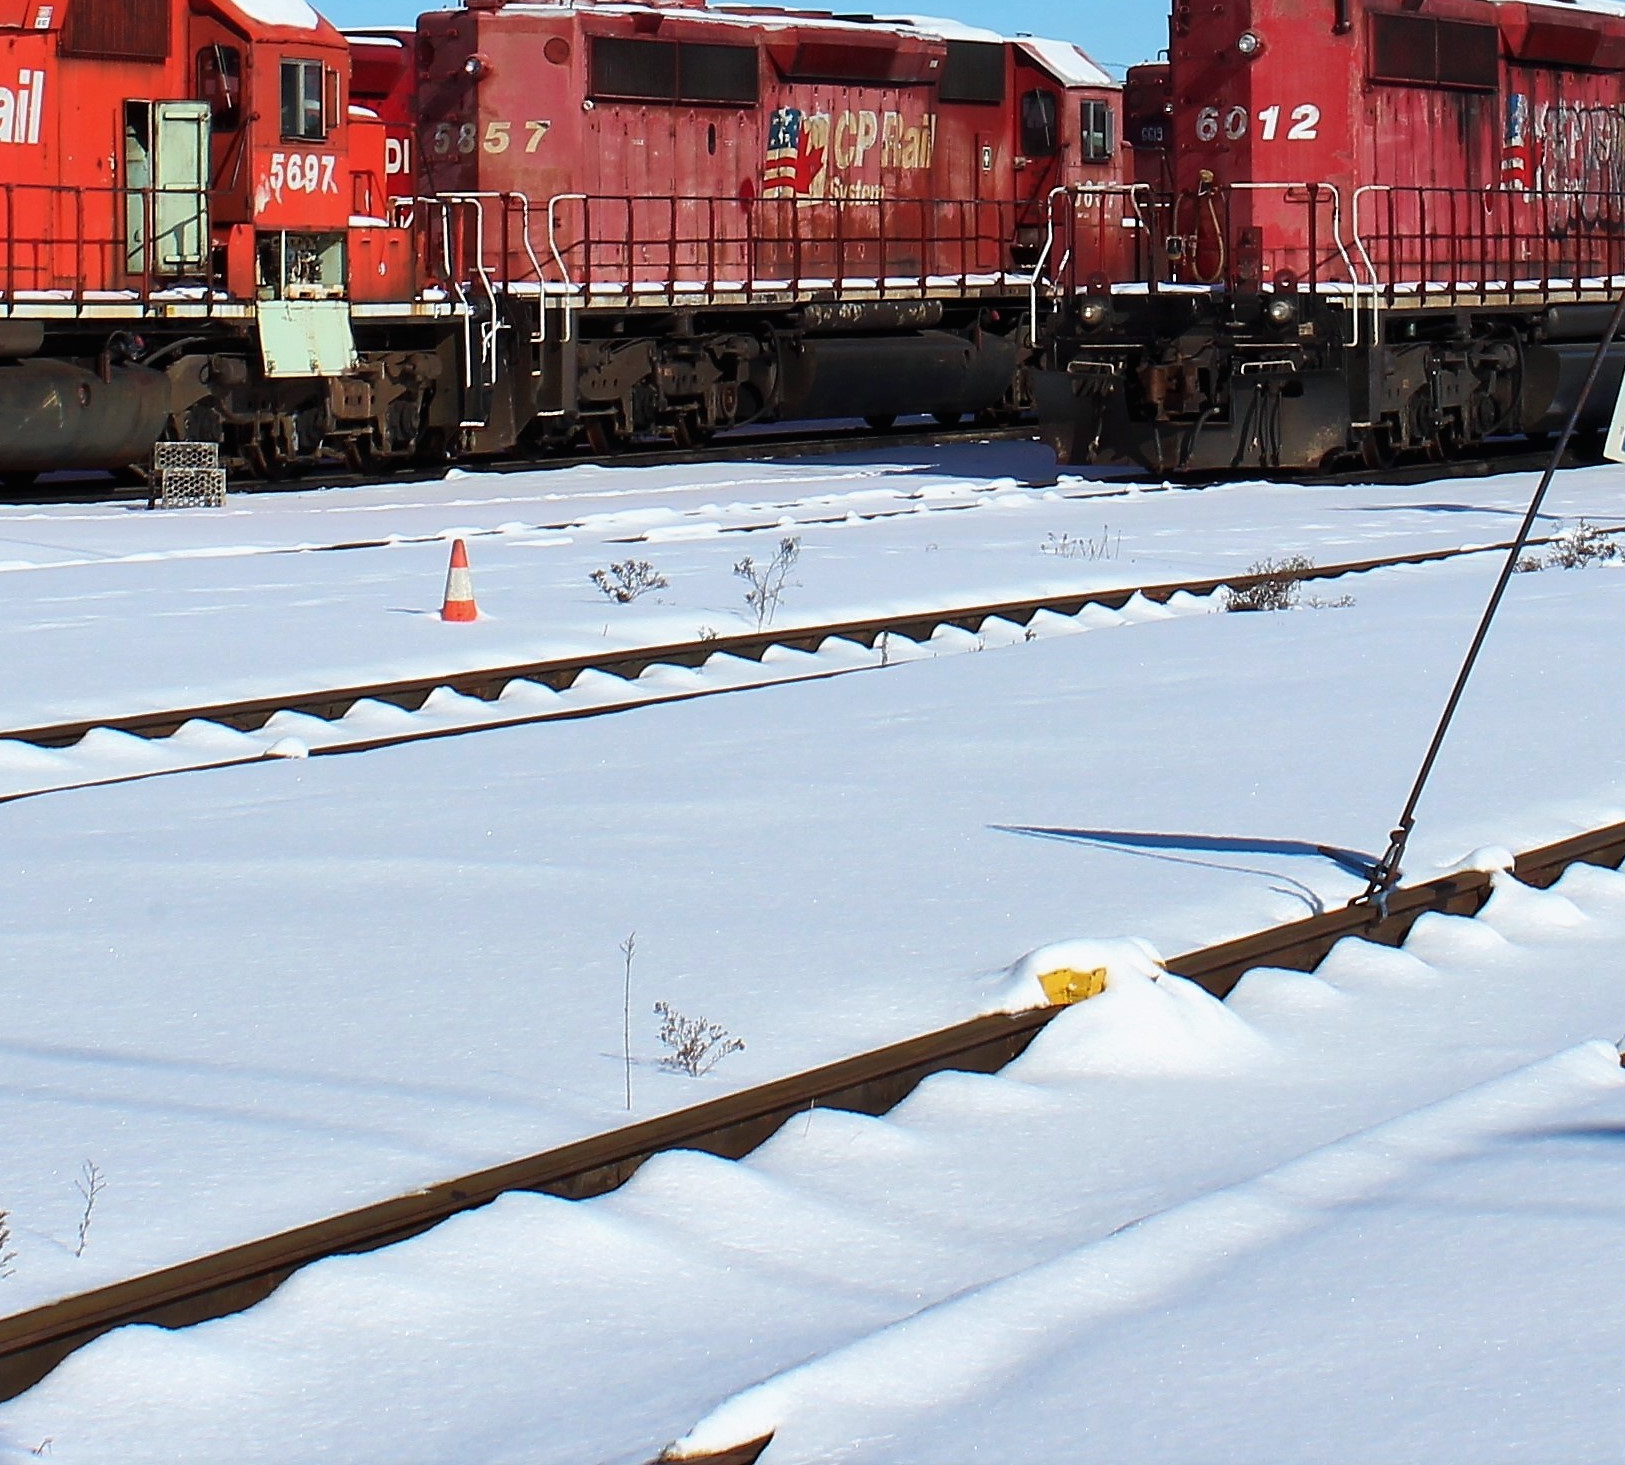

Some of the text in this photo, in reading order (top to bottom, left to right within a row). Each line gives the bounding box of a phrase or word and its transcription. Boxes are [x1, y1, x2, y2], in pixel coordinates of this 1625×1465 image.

[434, 120, 551, 154] 5857
[1196, 104, 1320, 141] 6012
[269, 153, 337, 194] 5697
